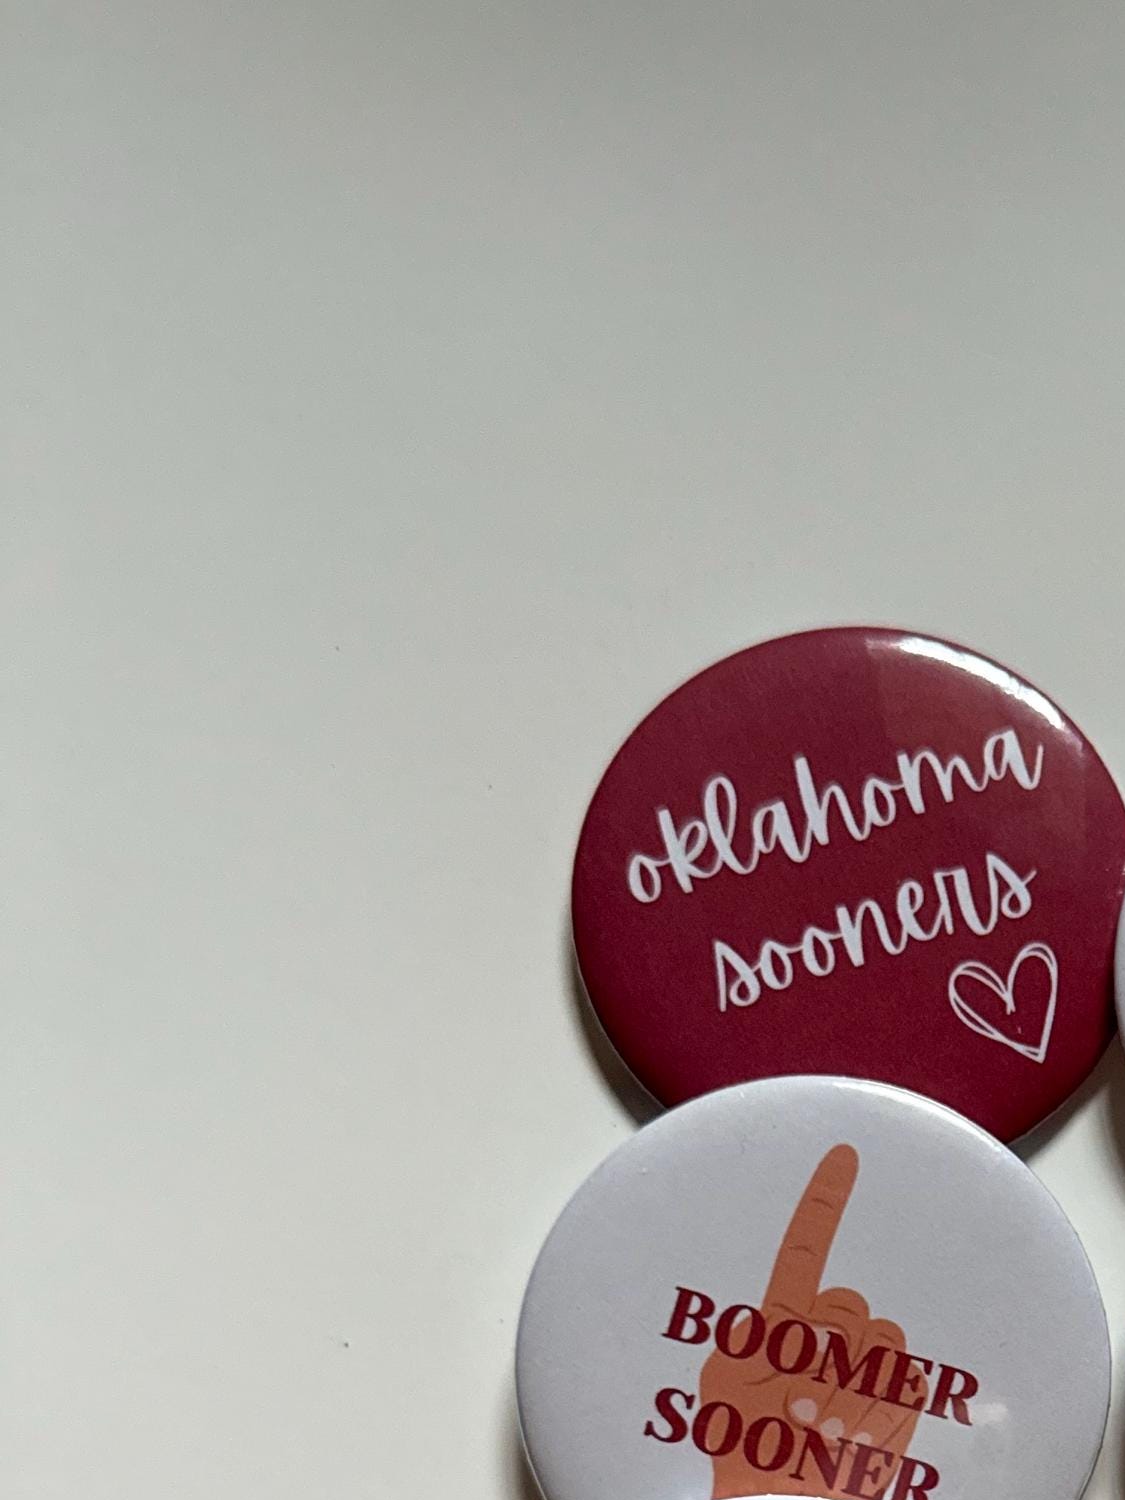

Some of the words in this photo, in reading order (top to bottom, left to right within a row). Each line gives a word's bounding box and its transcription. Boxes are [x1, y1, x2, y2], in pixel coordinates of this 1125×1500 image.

[627, 728, 1044, 903] oklahoma
[714, 853, 1038, 1013] sooners
[661, 1285, 980, 1427] BOOMER
